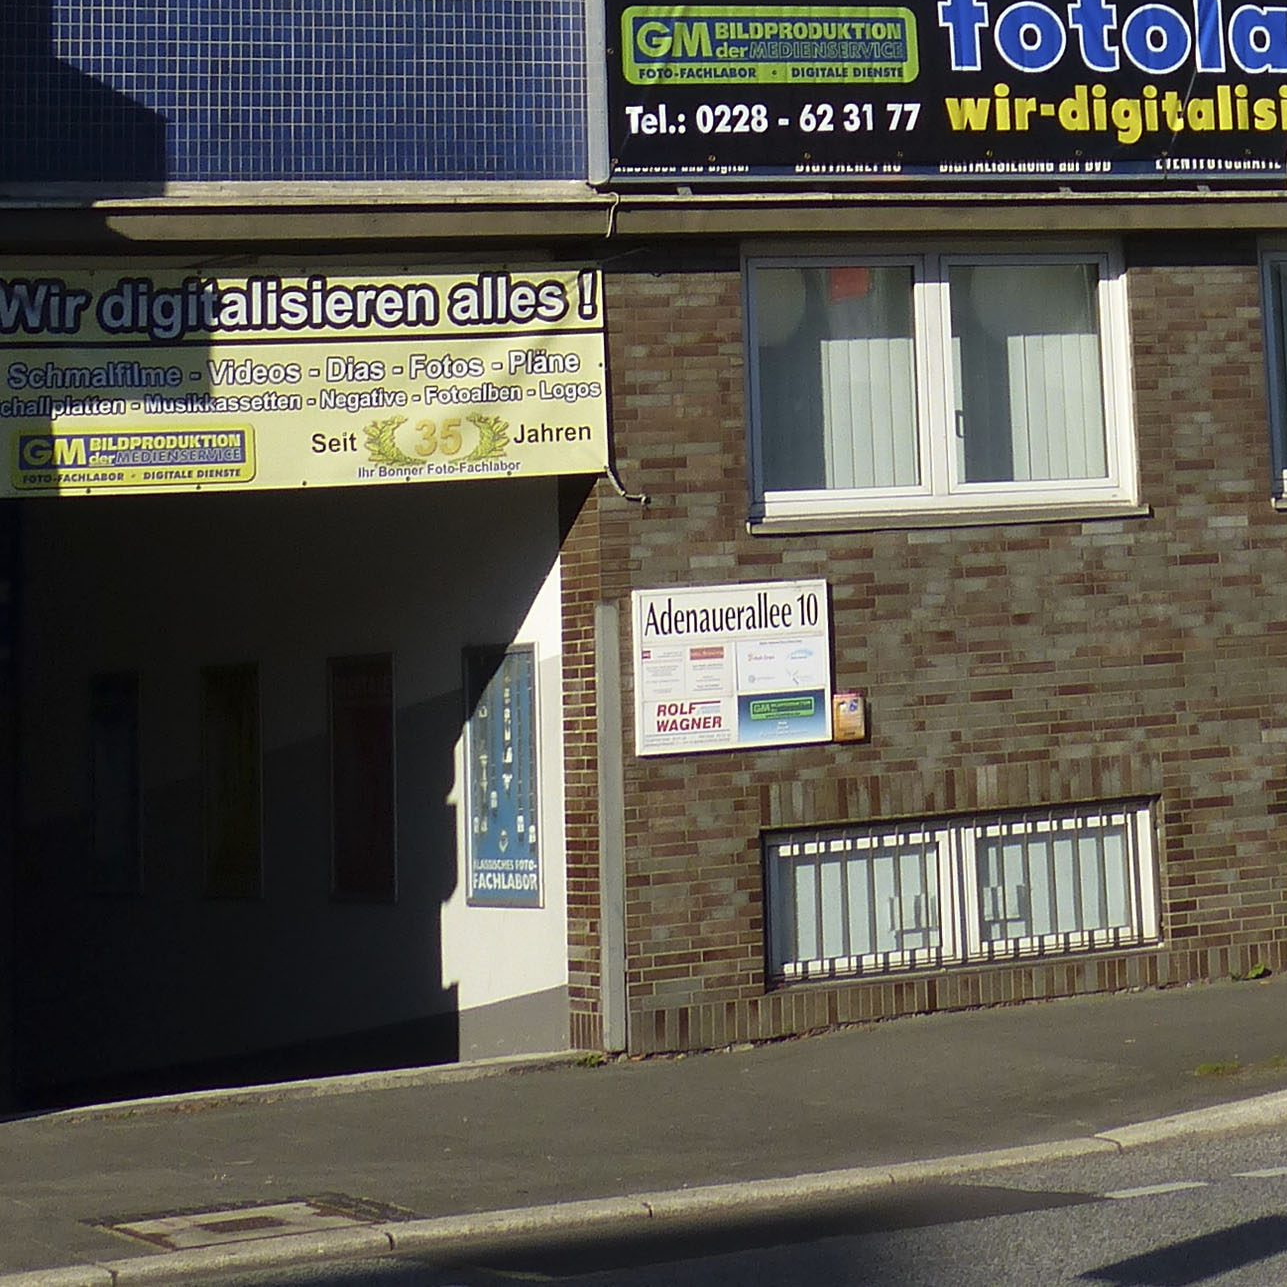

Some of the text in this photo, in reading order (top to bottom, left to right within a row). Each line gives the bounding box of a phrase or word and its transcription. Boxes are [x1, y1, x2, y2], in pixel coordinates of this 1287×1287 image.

[636, 21, 901, 58] GM BILDPRODUKTION
[715, 42, 904, 60] der MEDIENSERVICE
[638, 66, 904, 79] FOTO-FACHLABOR DIGITALE DIENSTE
[625, 104, 687, 134] Tel.:
[696, 104, 769, 134] 0228
[799, 103, 834, 133] 62
[843, 103, 874, 133] 31
[886, 103, 921, 132] 77
[0, 281, 88, 329] Wir
[101, 275, 436, 340] digitalisieren
[451, 275, 567, 321] alles
[8, 362, 183, 389] Schmalfilme
[207, 359, 303, 386] Videos
[326, 356, 385, 382] Dias
[409, 354, 485, 380] Fotos
[508, 349, 581, 375] Pläne
[0, 395, 126, 420] challplatten
[145, 390, 302, 415] Musikkassetten
[319, 388, 408, 413] Negative
[424, 382, 523, 406] Fotoalben
[539, 380, 602, 403] Logos
[311, 417, 592, 457] Seit 35 Jahren
[23, 434, 241, 467] GM BILDPRODUKTION
[89, 447, 242, 467] der MEDIENSERVICE
[23, 468, 242, 484] FOTO-FACHLABOR DIGITALE DIENSTE
[358, 460, 521, 479] Ihr Bonner Foto-Fachlabor
[644, 592, 819, 637] Adenauerallee 10
[657, 702, 698, 717] ROLF
[656, 716, 723, 733] WAGNER
[515, 858, 538, 871] FOTO-
[472, 871, 538, 891] FACHLABOR
